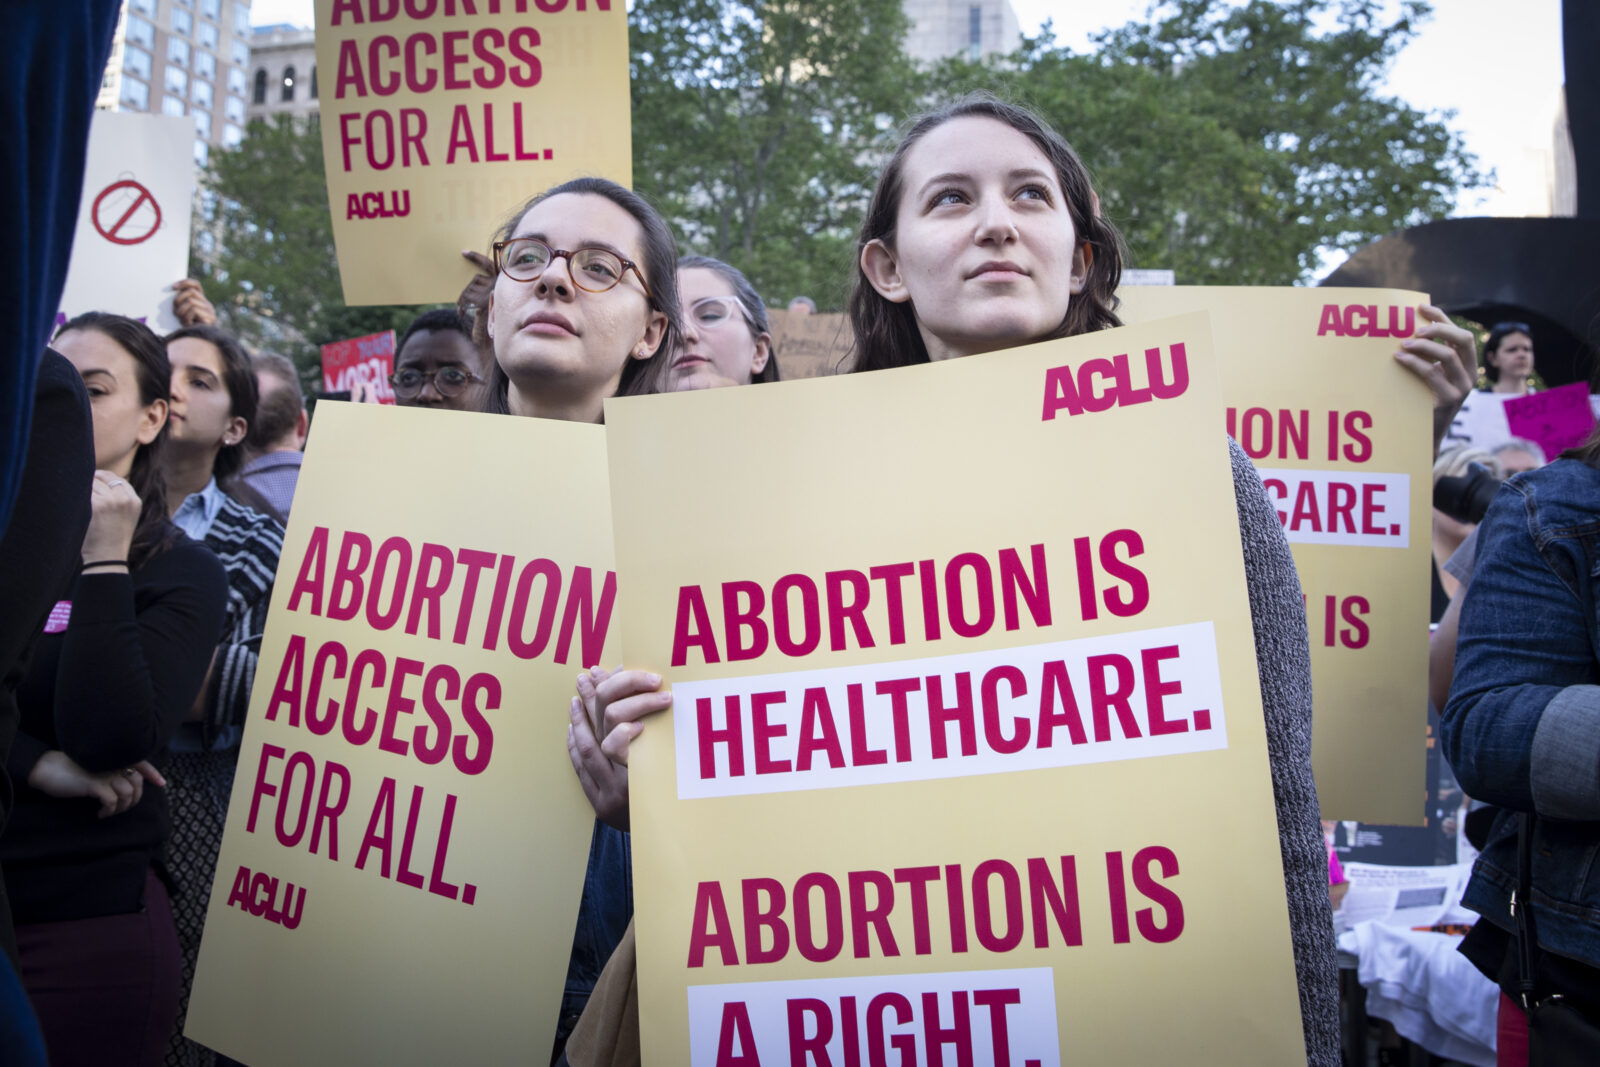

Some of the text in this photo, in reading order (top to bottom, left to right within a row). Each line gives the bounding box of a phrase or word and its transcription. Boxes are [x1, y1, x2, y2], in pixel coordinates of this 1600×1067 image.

[335, 26, 542, 99] ACCESS
[339, 102, 553, 172] FOR ALL.
[346, 189, 411, 220] ACLU
[1317, 304, 1415, 338] ACLU
[1042, 342, 1190, 421] ACLU
[1328, 410, 1373, 463] IS
[286, 526, 618, 670] ABORTION
[670, 528, 1150, 667] ABORTION IS
[1324, 595, 1370, 649] IS
[265, 634, 502, 776] ACCESS
[695, 644, 1212, 780] HEALTHCARE.
[246, 743, 478, 906] FOR ALL.
[227, 866, 307, 930] ACLU
[687, 845, 1185, 969] ABORTION IS
[716, 1001, 762, 1067] A
